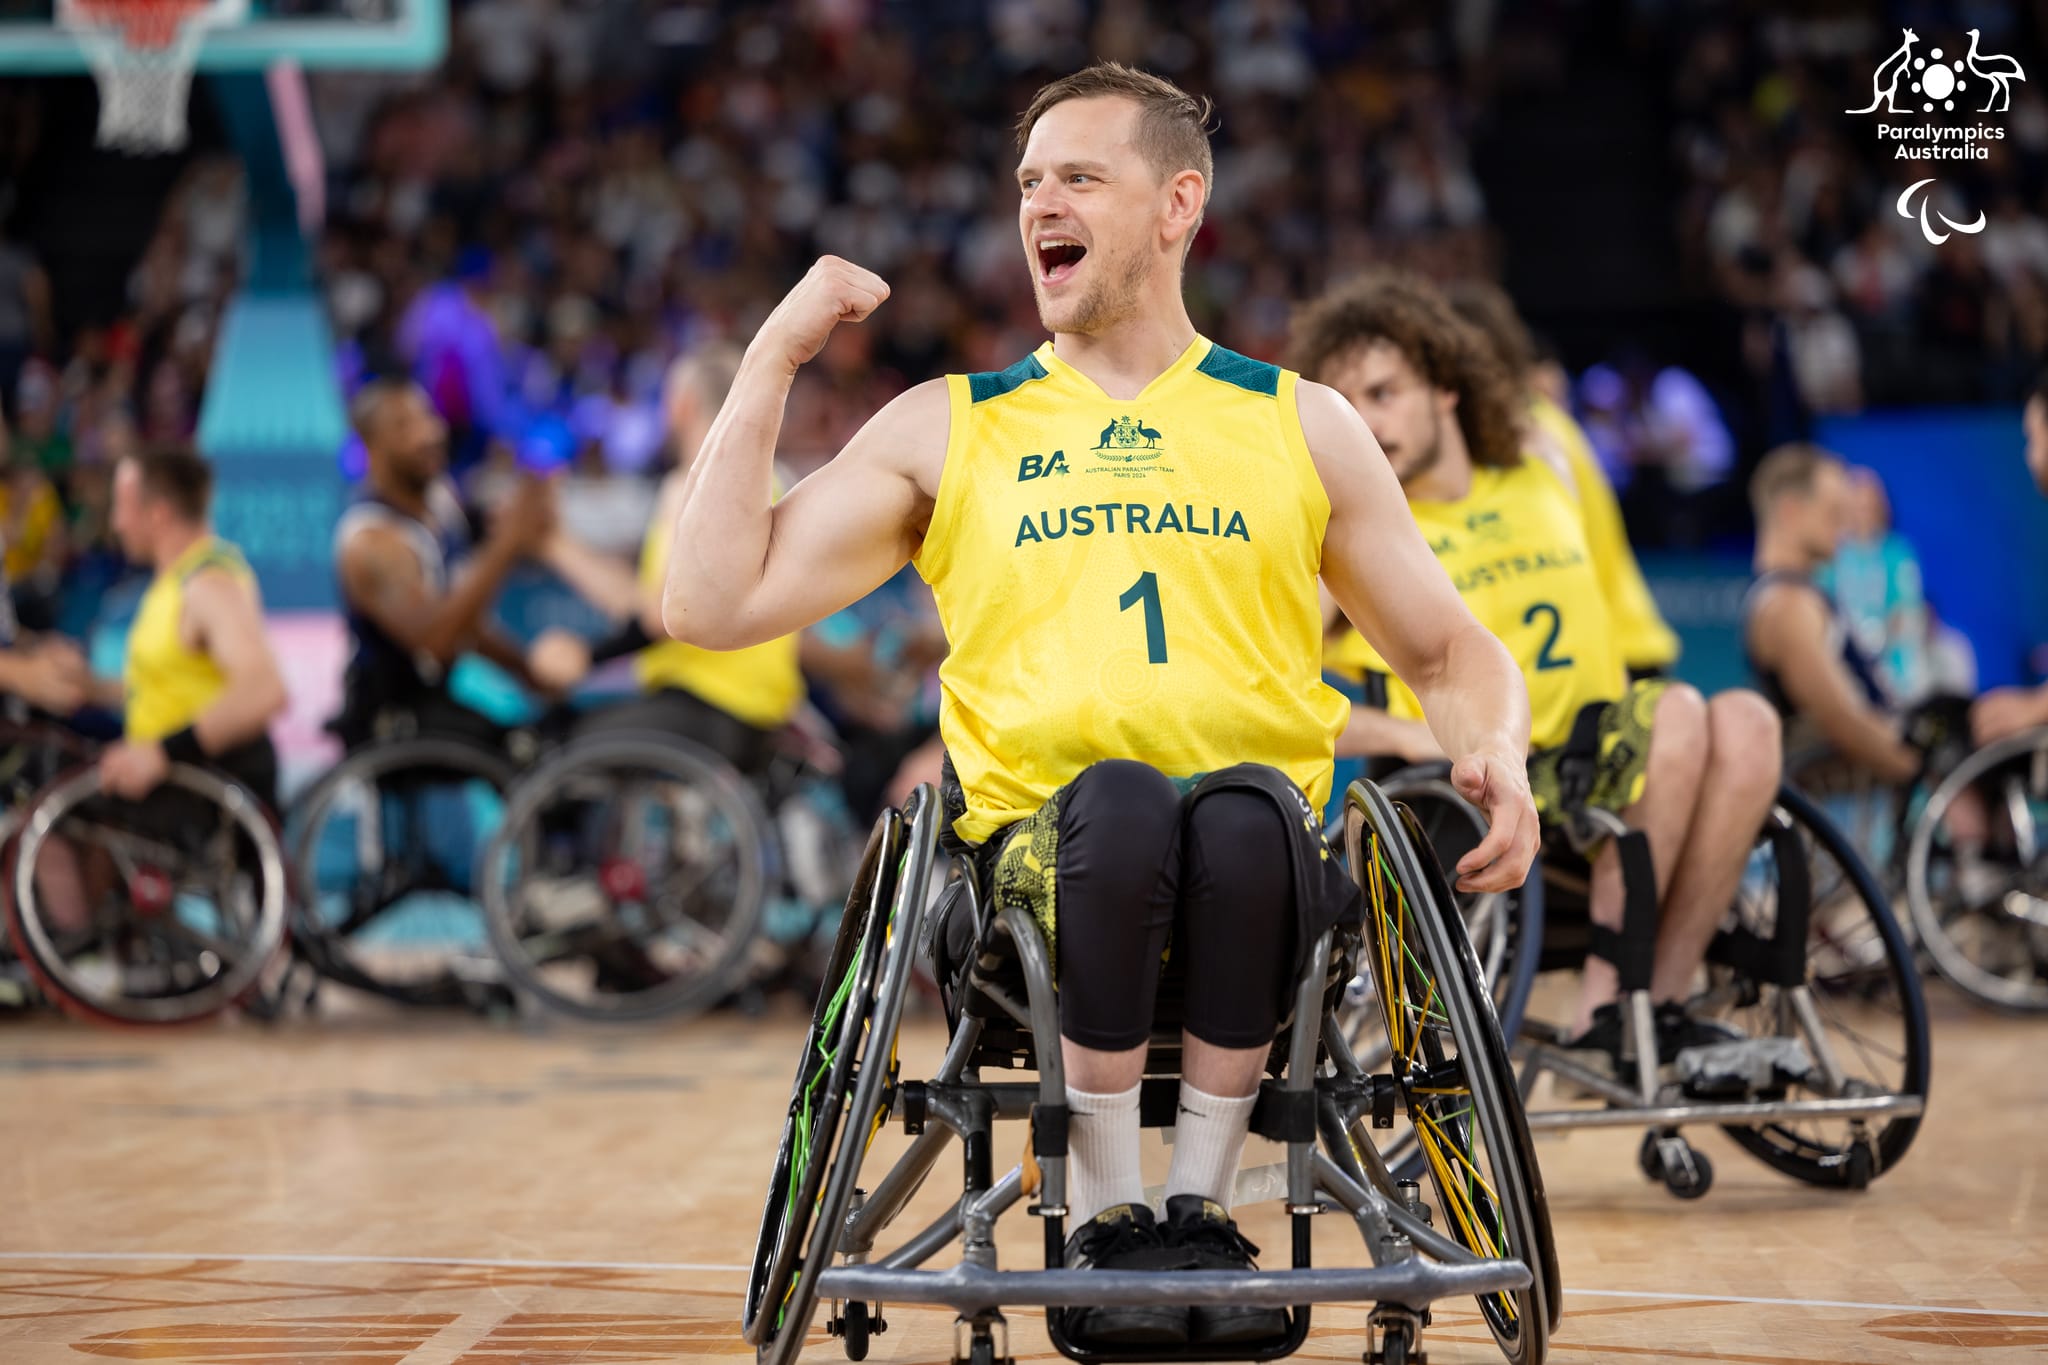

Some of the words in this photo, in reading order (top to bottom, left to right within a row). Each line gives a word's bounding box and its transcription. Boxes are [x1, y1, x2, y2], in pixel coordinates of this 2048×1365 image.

[1017, 450, 1067, 482] BA
[1085, 466, 1121, 474] AUSTRALIAN
[1014, 502, 1251, 548] AUSTRALIA
[1119, 570, 1168, 664] 1
[1522, 601, 1575, 673] 2
